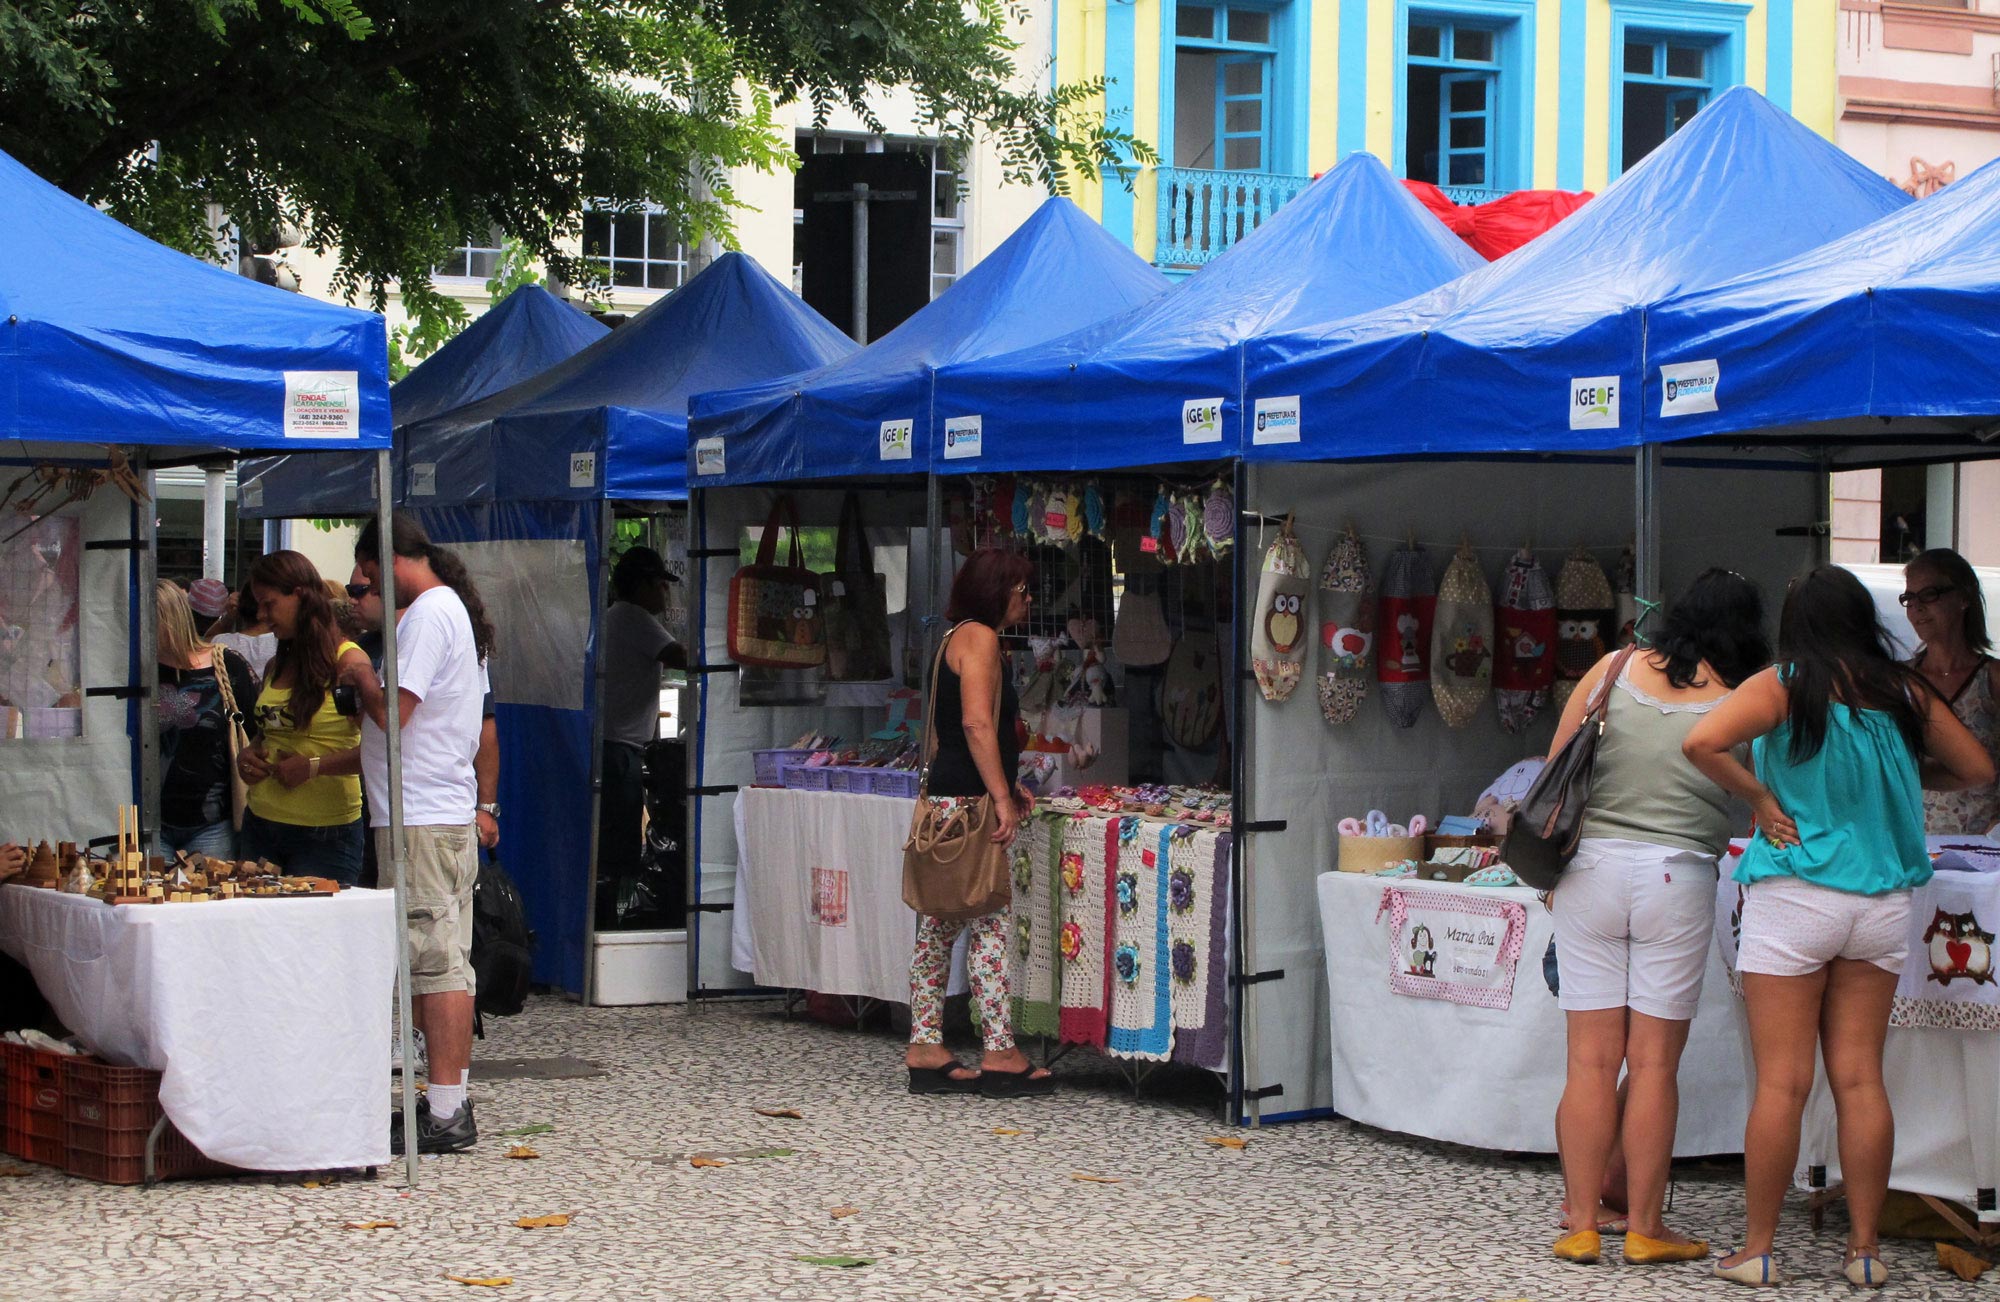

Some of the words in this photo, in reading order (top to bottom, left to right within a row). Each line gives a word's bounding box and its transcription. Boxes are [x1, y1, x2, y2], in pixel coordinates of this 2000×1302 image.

[1677, 377, 1708, 388] PREFEITURA
[1575, 387, 1614, 406] IGEOF
[1186, 406, 1217, 424] IGEOF
[883, 427, 909, 442] IGEOF
[1444, 926, 1475, 944] Maria
